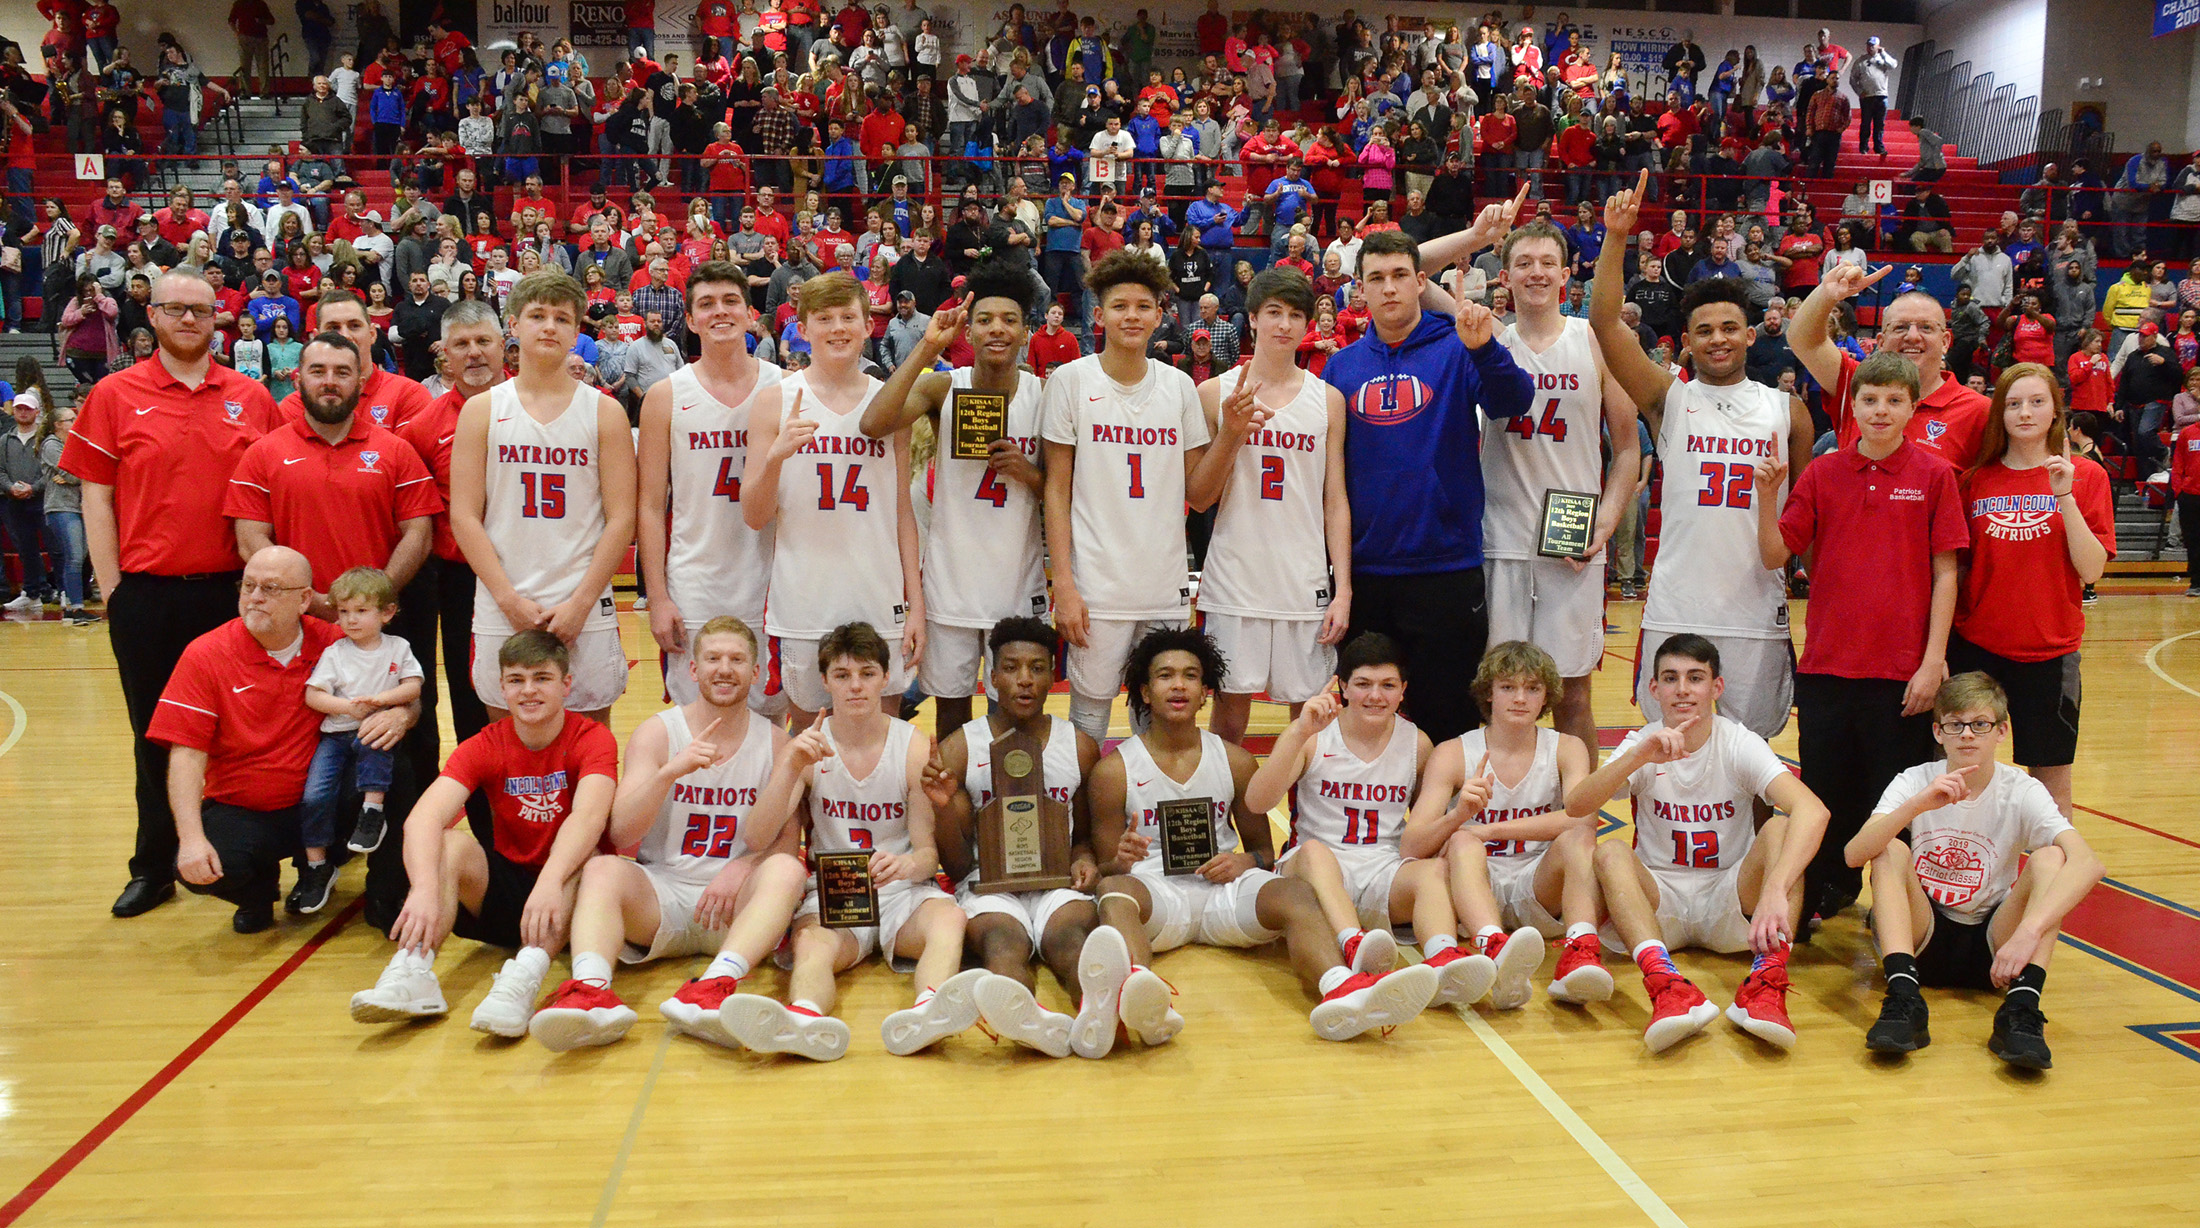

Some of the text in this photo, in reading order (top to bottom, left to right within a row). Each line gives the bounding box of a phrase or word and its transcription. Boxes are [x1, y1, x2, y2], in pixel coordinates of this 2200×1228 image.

[493, 0, 550, 23] balfour
[573, 3, 626, 27] RENO
[2162, 0, 2199, 16] CHAM
[2175, 7, 2199, 29] 200
[1612, 27, 1672, 37] NESCO
[1614, 42, 1638, 52] NOW
[83, 156, 98, 176] A
[1096, 160, 1109, 178] B
[1874, 183, 1886, 199] C
[1530, 373, 1579, 391] IOTS
[1379, 386, 1398, 411] L
[960, 409, 975, 417] 12th
[972, 416, 989, 425] Boys
[962, 423, 998, 431] Basketball
[1092, 424, 1177, 446] PATRIOTS
[688, 429, 748, 450] PATRI
[1245, 428, 1316, 453] TRIOTS
[1686, 434, 1772, 458] PATRIOTS
[498, 445, 588, 466] PATRIOTS
[712, 456, 746, 502] 4
[816, 462, 869, 512] 14
[974, 465, 1007, 507] 4
[1127, 453, 1145, 499] 1
[1261, 455, 1285, 501] 2
[1697, 461, 1755, 510] 32
[520, 472, 566, 519] 15
[1972, 495, 2062, 518] LINCOLN COUN
[1561, 515, 1577, 523] Boys
[1566, 508, 1590, 518] Region
[1551, 520, 1586, 530] Basketball
[1985, 521, 2051, 541] PATRIOTS
[1547, 538, 1584, 547] Tournament
[673, 782, 757, 807] PATRIOTS
[1319, 779, 1407, 803] PATRIOTS
[822, 797, 905, 822] PATRIOTS
[1472, 803, 1552, 825] ATRIOTS
[1653, 799, 1735, 823] PATRIOTS
[1180, 826, 1196, 834] Boys
[1184, 818, 1208, 826] Region
[1341, 806, 1379, 845] 11
[680, 813, 738, 859] 22
[1171, 833, 1207, 842] Basketball
[1948, 838, 1969, 849] 2019
[1171, 852, 1210, 861] Tournament
[1671, 829, 1719, 869] 12
[841, 871, 868, 879] Region
[1919, 861, 1980, 885] Patriot Classic
